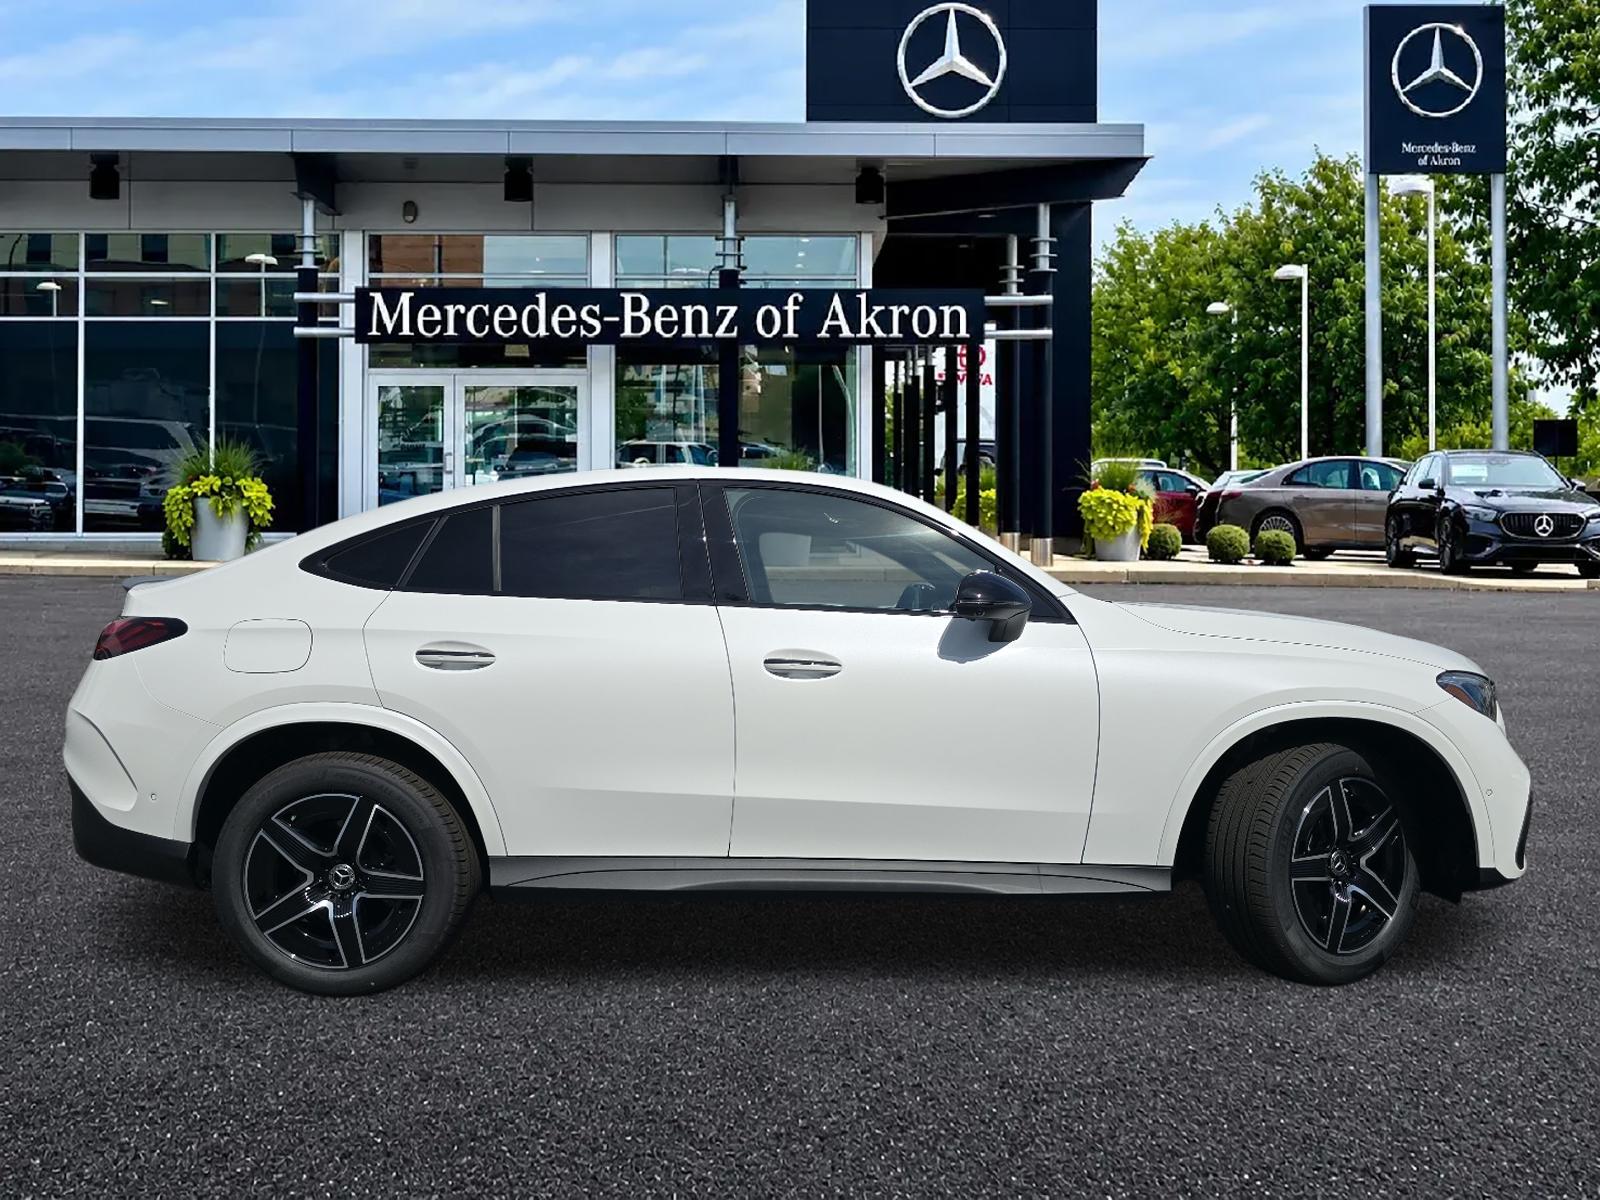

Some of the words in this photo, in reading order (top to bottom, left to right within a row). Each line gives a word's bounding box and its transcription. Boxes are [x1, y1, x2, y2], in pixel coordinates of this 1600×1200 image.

[1402, 142, 1476, 153] Mercedes-Benz
[1418, 155, 1428, 165] of
[1430, 155, 1460, 165] Akron
[368, 292, 737, 337] Mercedes-Benz
[756, 293, 803, 337] of
[817, 292, 970, 337] Akron
